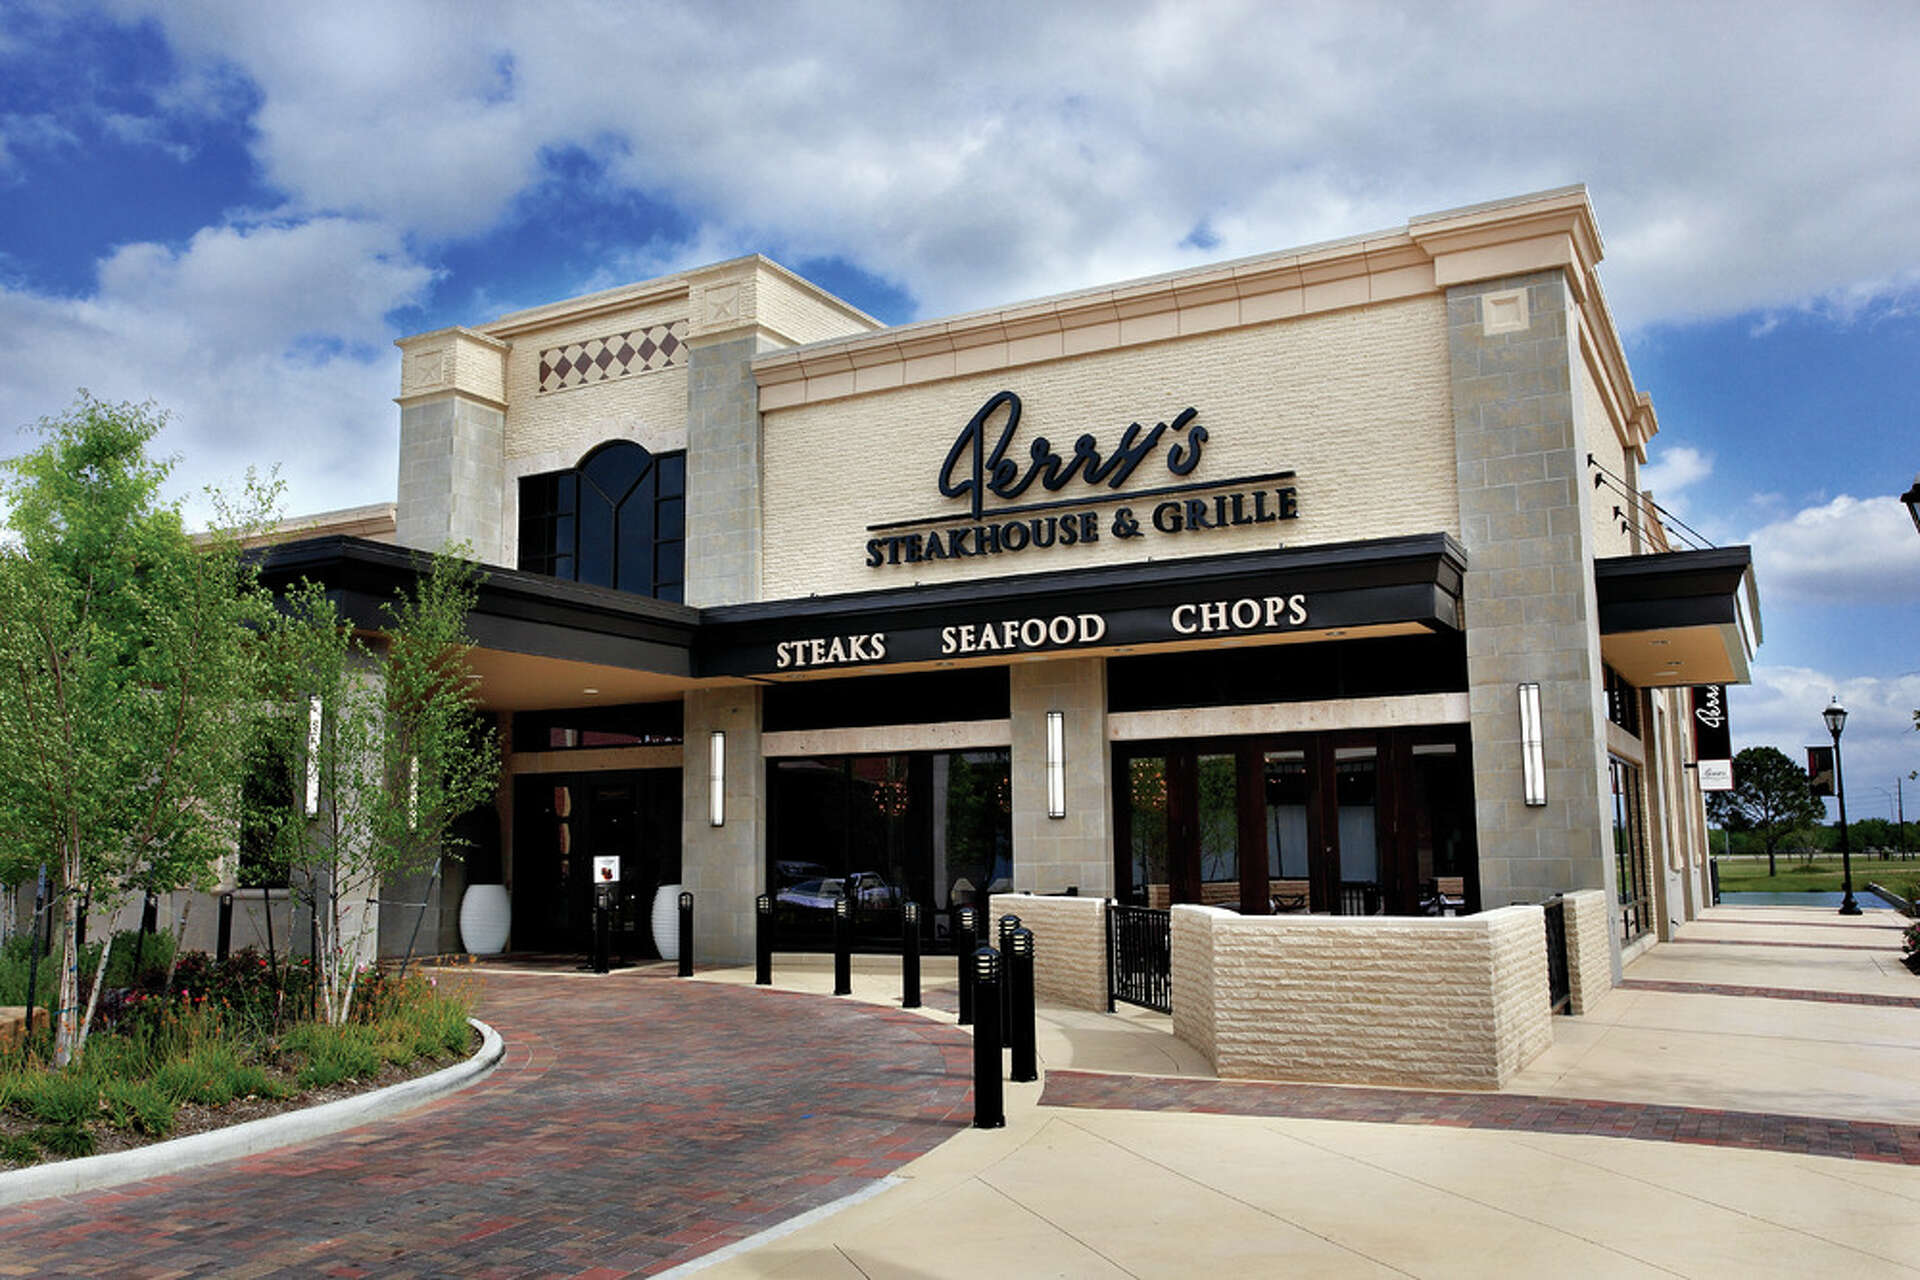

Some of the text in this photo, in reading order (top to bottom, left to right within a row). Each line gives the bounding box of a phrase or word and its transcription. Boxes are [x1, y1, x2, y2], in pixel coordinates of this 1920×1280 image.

[939, 391, 1208, 521] Perry's
[866, 487, 1298, 568] STEAKHOUSE & GRILLE
[777, 595, 1308, 668] STEAKS SEAFOOD CHOPS
